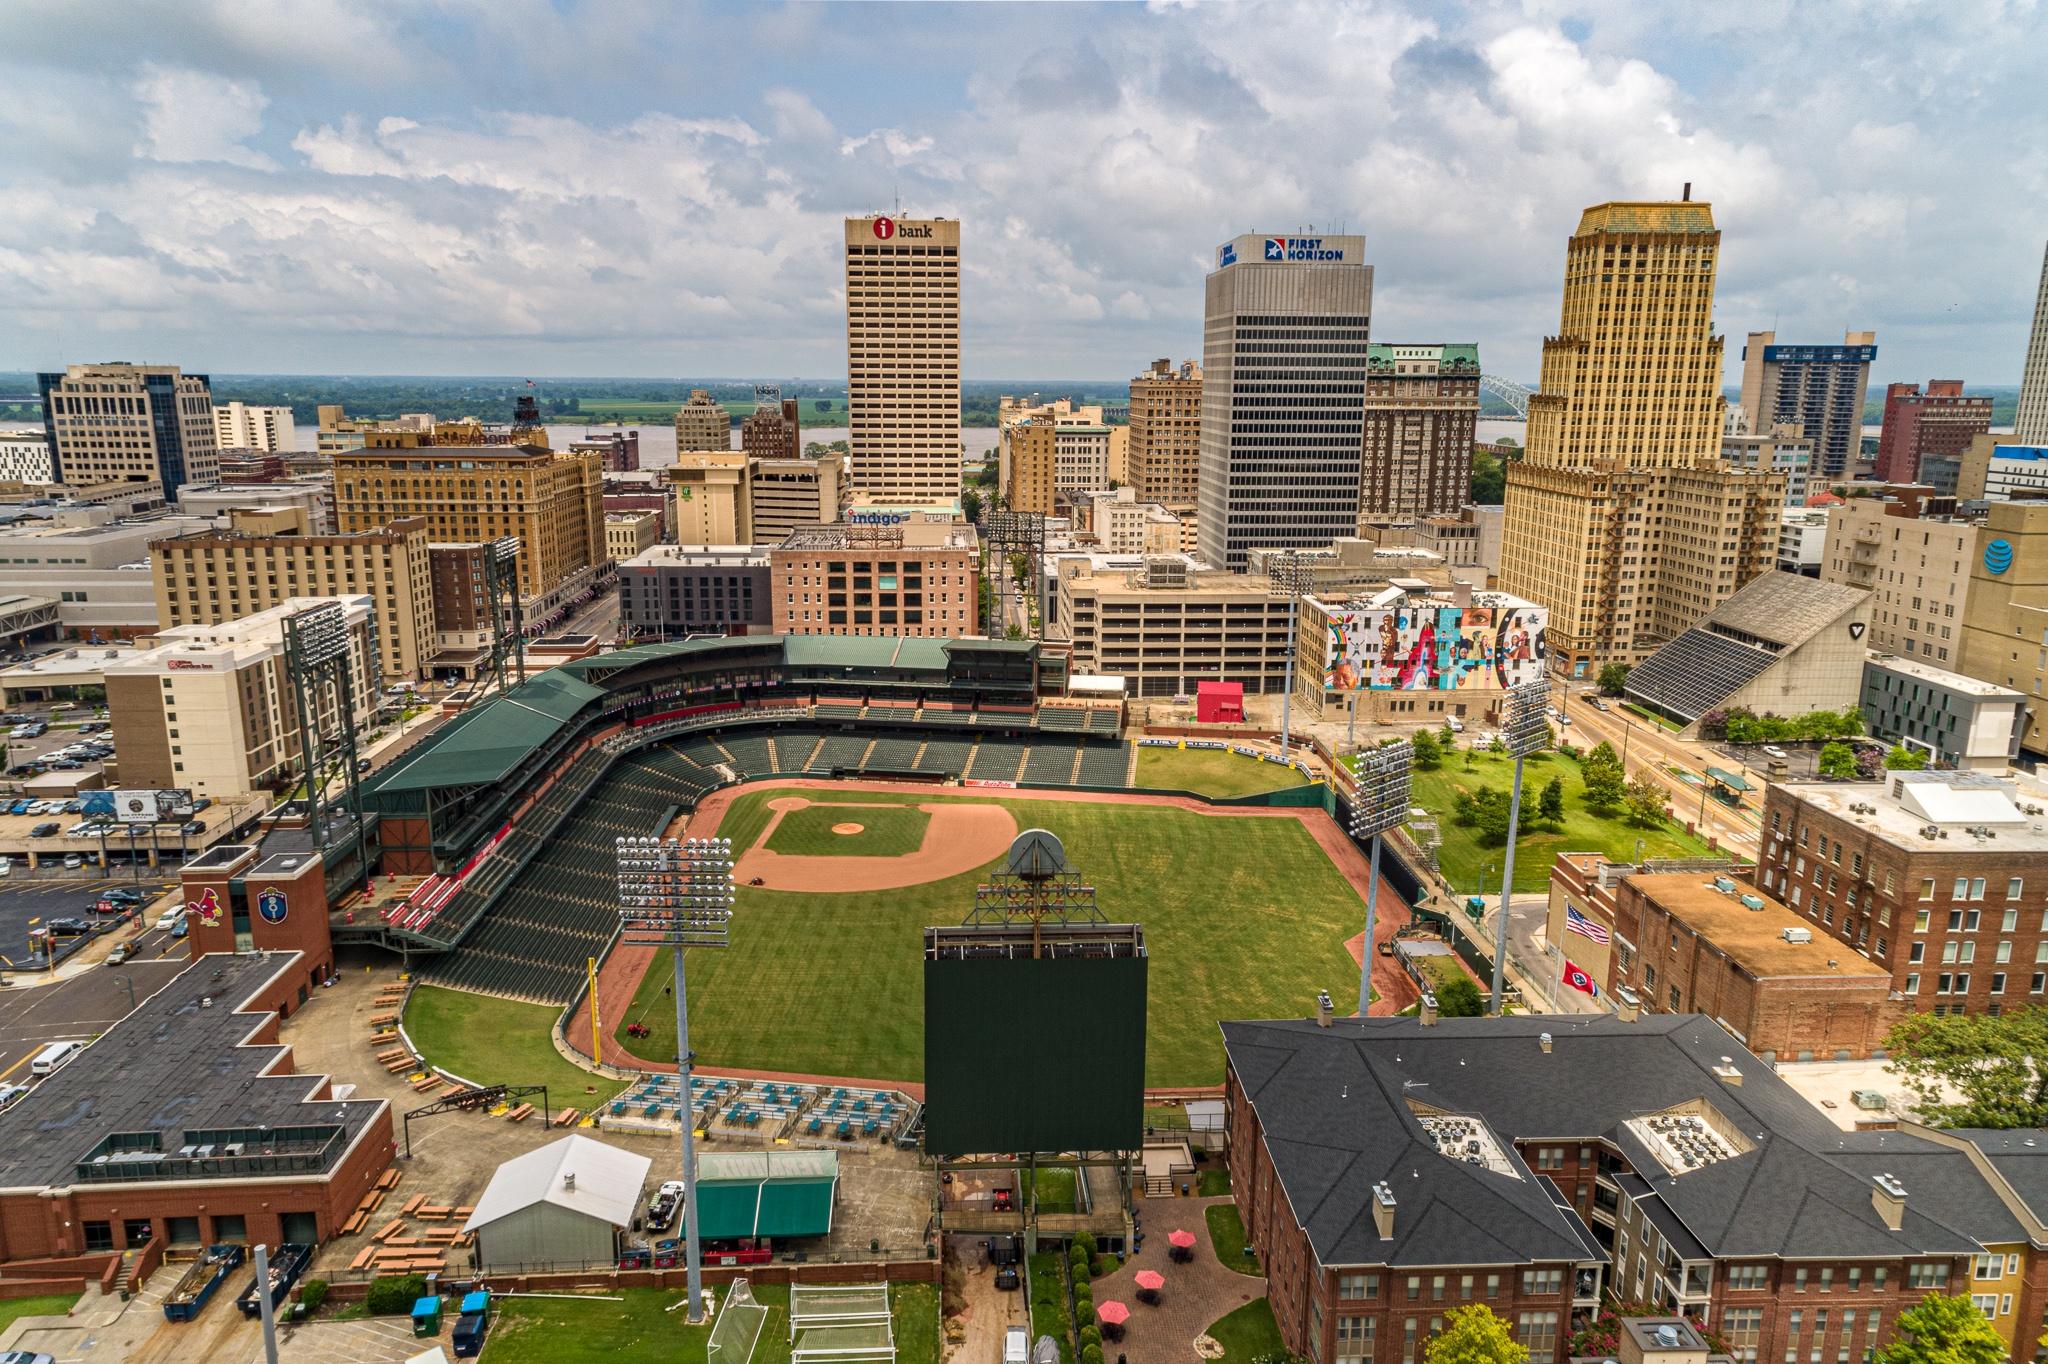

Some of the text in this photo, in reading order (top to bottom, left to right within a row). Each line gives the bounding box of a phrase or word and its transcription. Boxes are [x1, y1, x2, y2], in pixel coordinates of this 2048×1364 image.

[899, 224, 933, 238] bank
[1288, 239, 1322, 249] FIRST
[1288, 250, 1344, 261] HORIZON
[450, 434, 518, 446] PEABODY
[852, 512, 901, 526] indigo
